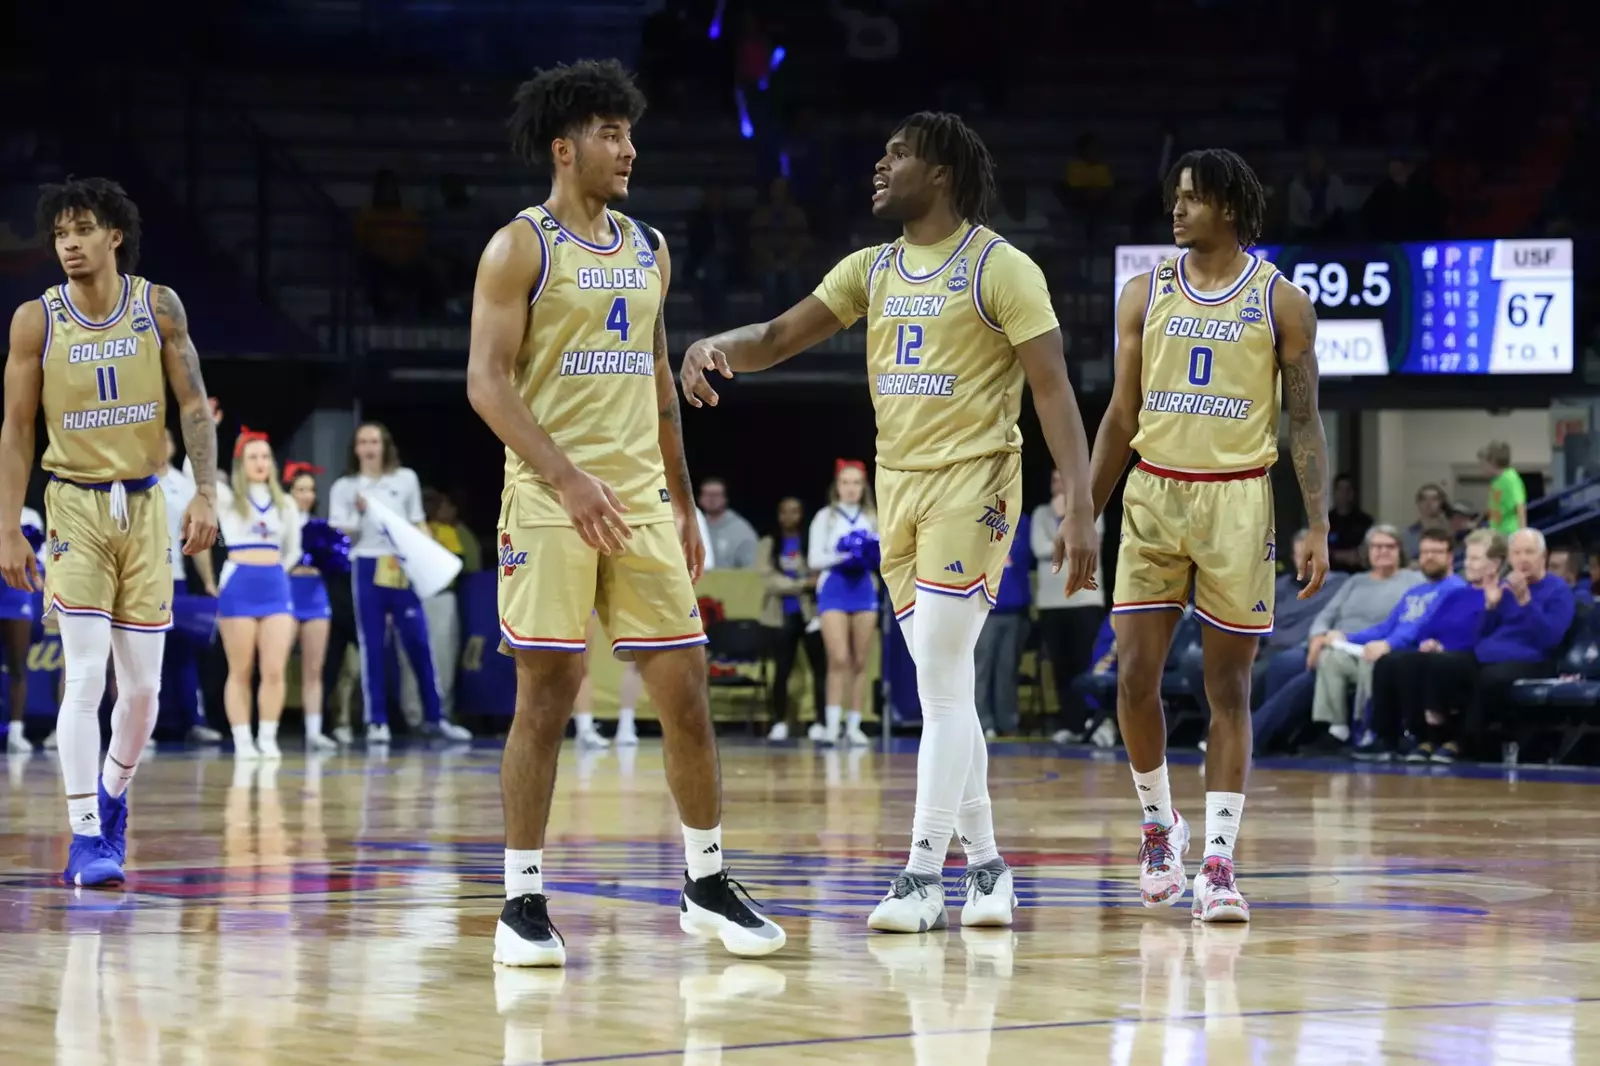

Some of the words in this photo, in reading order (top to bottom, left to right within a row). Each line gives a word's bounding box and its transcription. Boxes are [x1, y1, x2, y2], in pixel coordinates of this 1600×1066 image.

[1444, 246, 1462, 268] P
[1468, 246, 1484, 268] F
[1513, 246, 1557, 267] USF
[577, 267, 648, 290] GOLDEN
[949, 279, 968, 288] DOC
[1160, 269, 1173, 279] 32
[1292, 262, 1391, 307] 59.5
[50, 300, 62, 310] 32
[882, 295, 947, 318] GOLDEN
[1240, 311, 1261, 320] DOC
[1507, 293, 1555, 328] 67
[132, 319, 151, 329] DOC
[604, 296, 631, 343] 4
[1164, 316, 1245, 343] GOLDEN
[68, 336, 138, 365] GOLDEN
[895, 323, 924, 367] 12
[1317, 336, 1373, 363] 2ND
[1188, 345, 1214, 387] 0
[95, 365, 119, 403] 11
[62, 401, 159, 430] HURRICANE
[1144, 391, 1253, 420] HURRICANE
